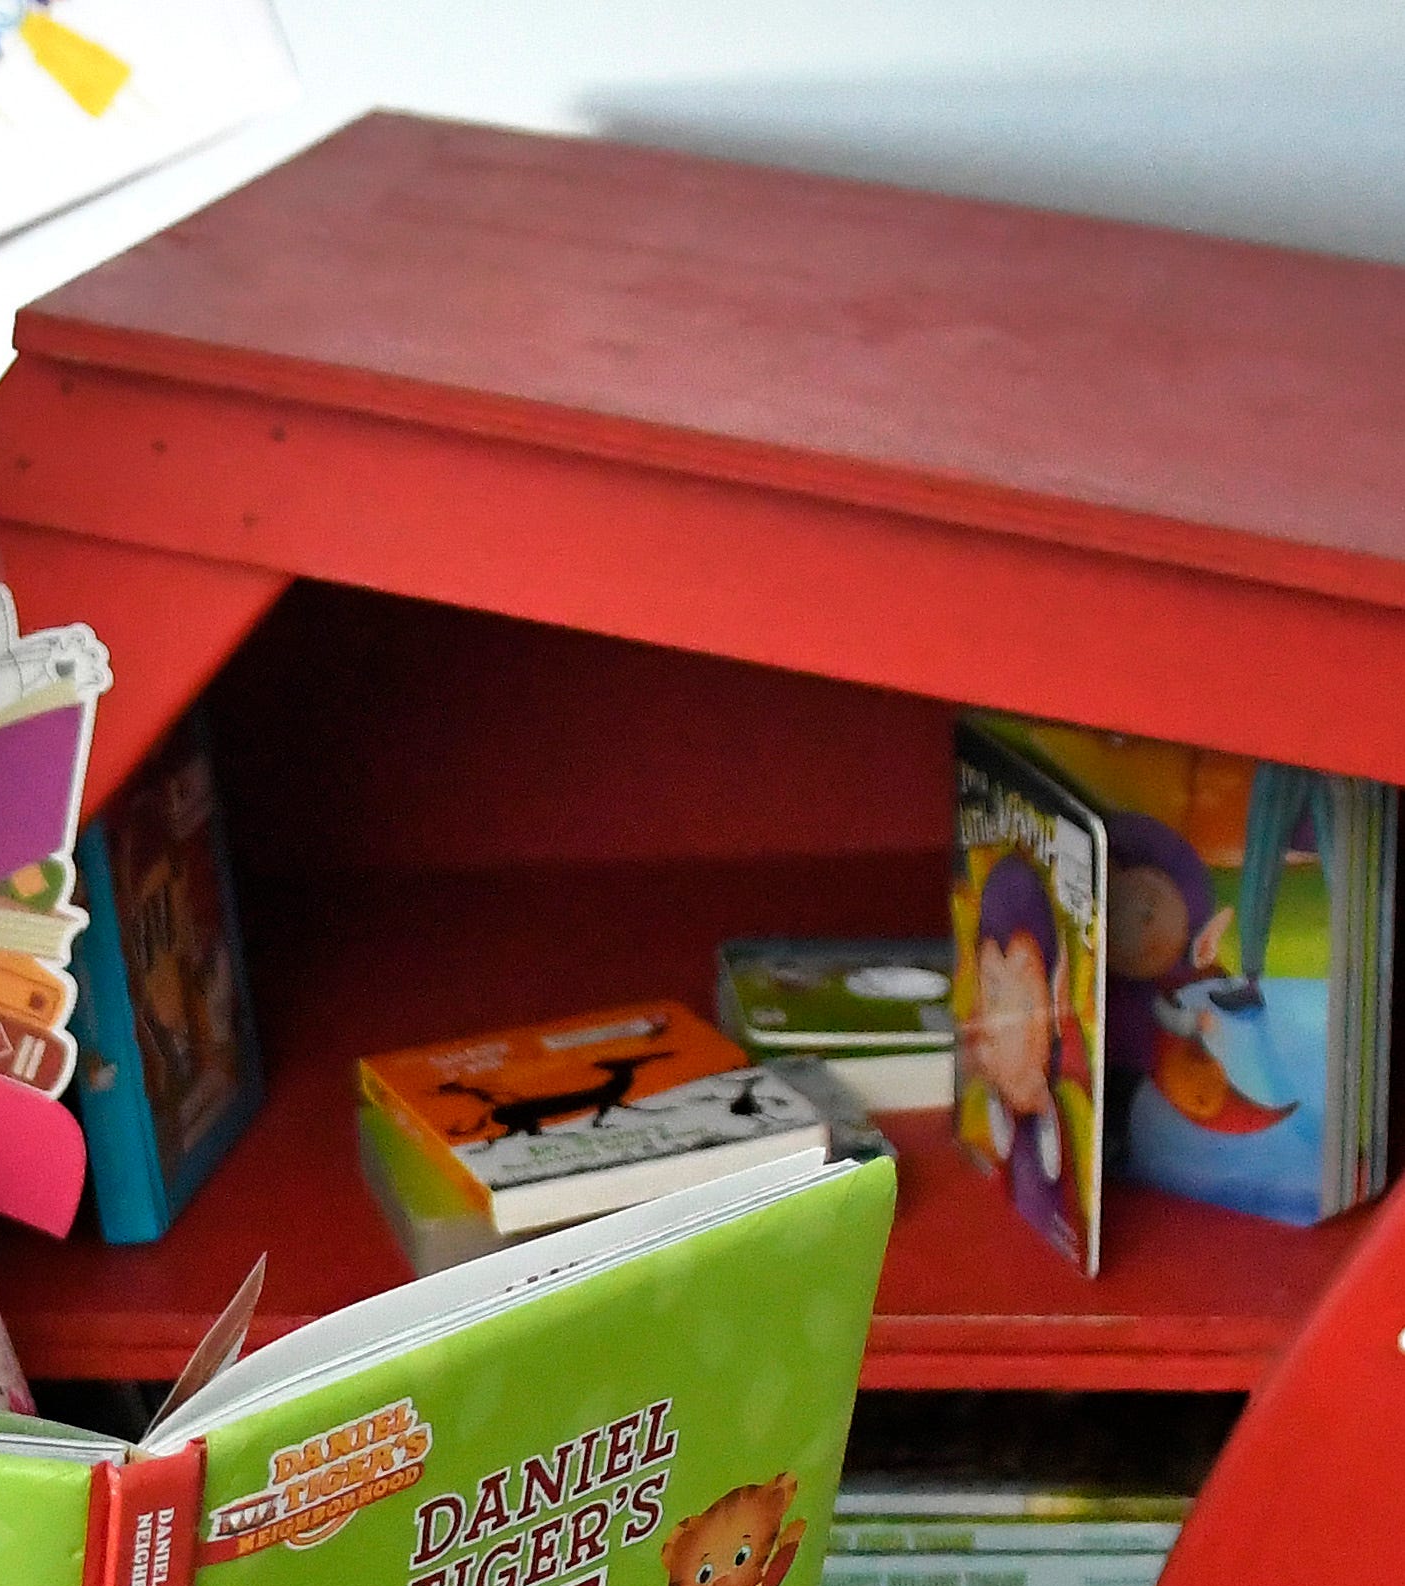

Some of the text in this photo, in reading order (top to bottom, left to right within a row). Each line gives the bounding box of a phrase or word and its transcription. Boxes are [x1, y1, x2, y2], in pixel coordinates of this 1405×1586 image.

[273, 1403, 413, 1485] DANIEL
[284, 1429, 428, 1513] TIGER'S
[412, 1401, 677, 1567] DANIEL
[236, 1466, 421, 1553] NEIGHBORHOOD
